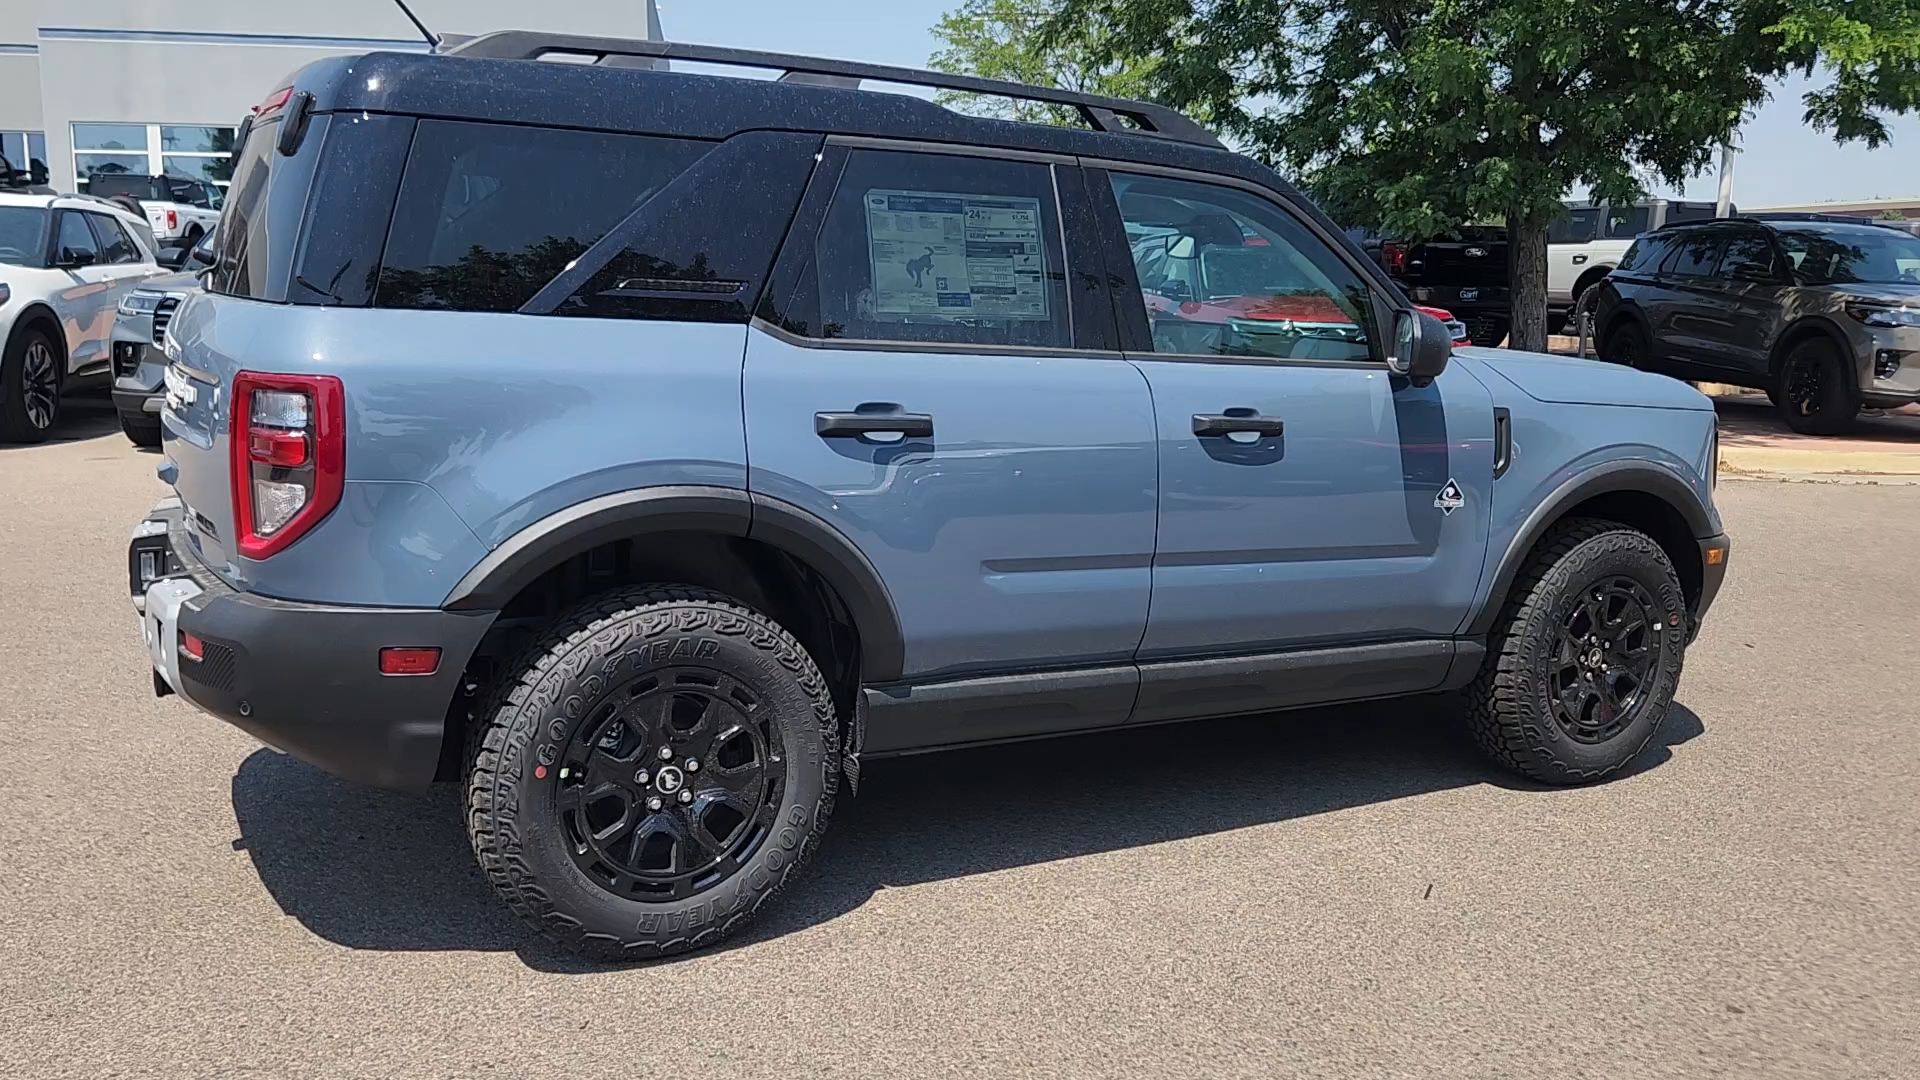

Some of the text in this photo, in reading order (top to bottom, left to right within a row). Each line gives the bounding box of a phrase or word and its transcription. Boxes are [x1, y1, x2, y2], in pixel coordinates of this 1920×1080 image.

[1460, 290, 1478, 299] Garff
[536, 637, 720, 766] GOODYEAR
[636, 803, 808, 934] GOODYEAR
